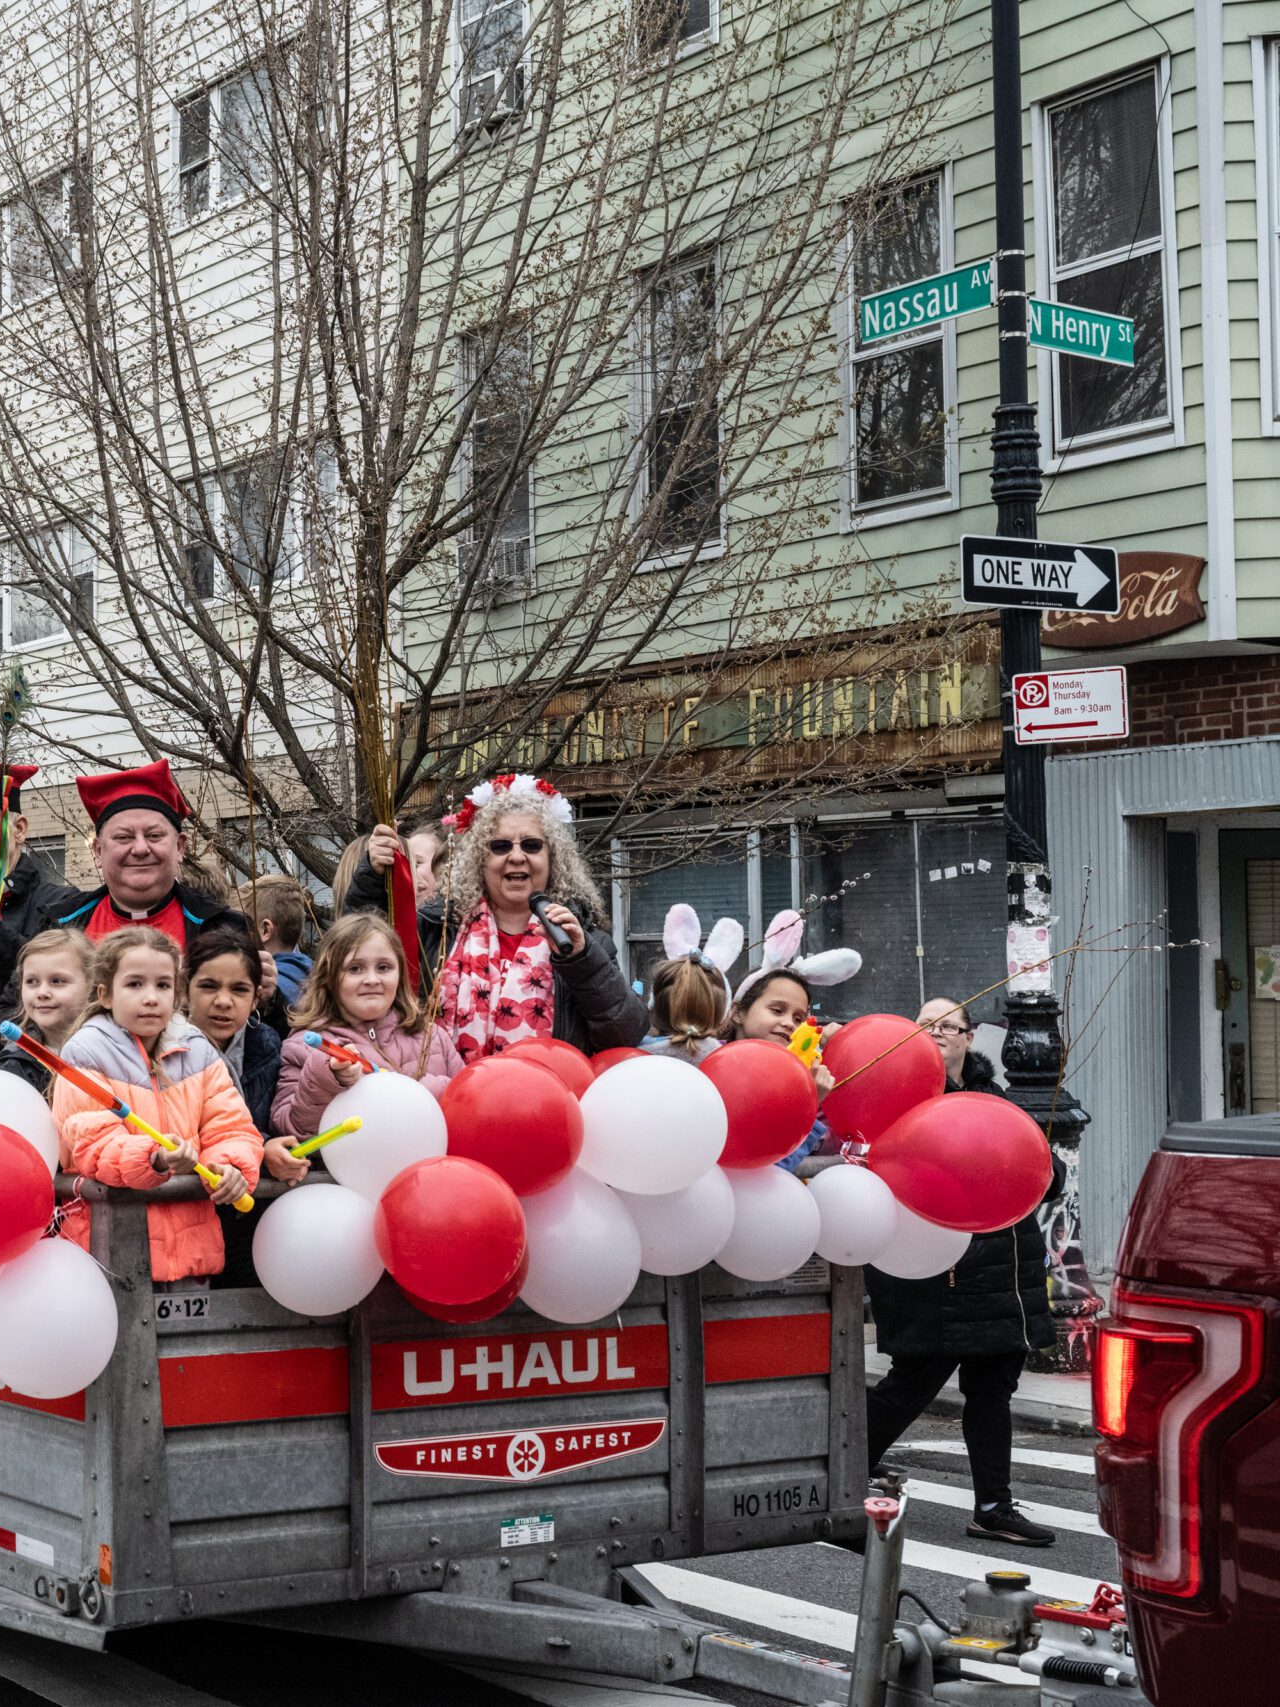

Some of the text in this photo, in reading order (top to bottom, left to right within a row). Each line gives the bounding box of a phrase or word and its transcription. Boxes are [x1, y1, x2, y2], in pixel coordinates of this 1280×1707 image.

[864, 267, 991, 337] Nassau Av
[1029, 303, 1131, 358] N Henry St
[981, 558, 1073, 589] ONE WAY
[1052, 680, 1084, 690] Monday
[1053, 690, 1091, 701] Thursday
[1054, 706, 1072, 716] 8am
[1080, 704, 1112, 713] 9:30am
[403, 1336, 635, 1396] U-HAUL
[416, 1431, 632, 1465] FINEST SAFEST
[733, 1485, 820, 1517] HO 1105 A
